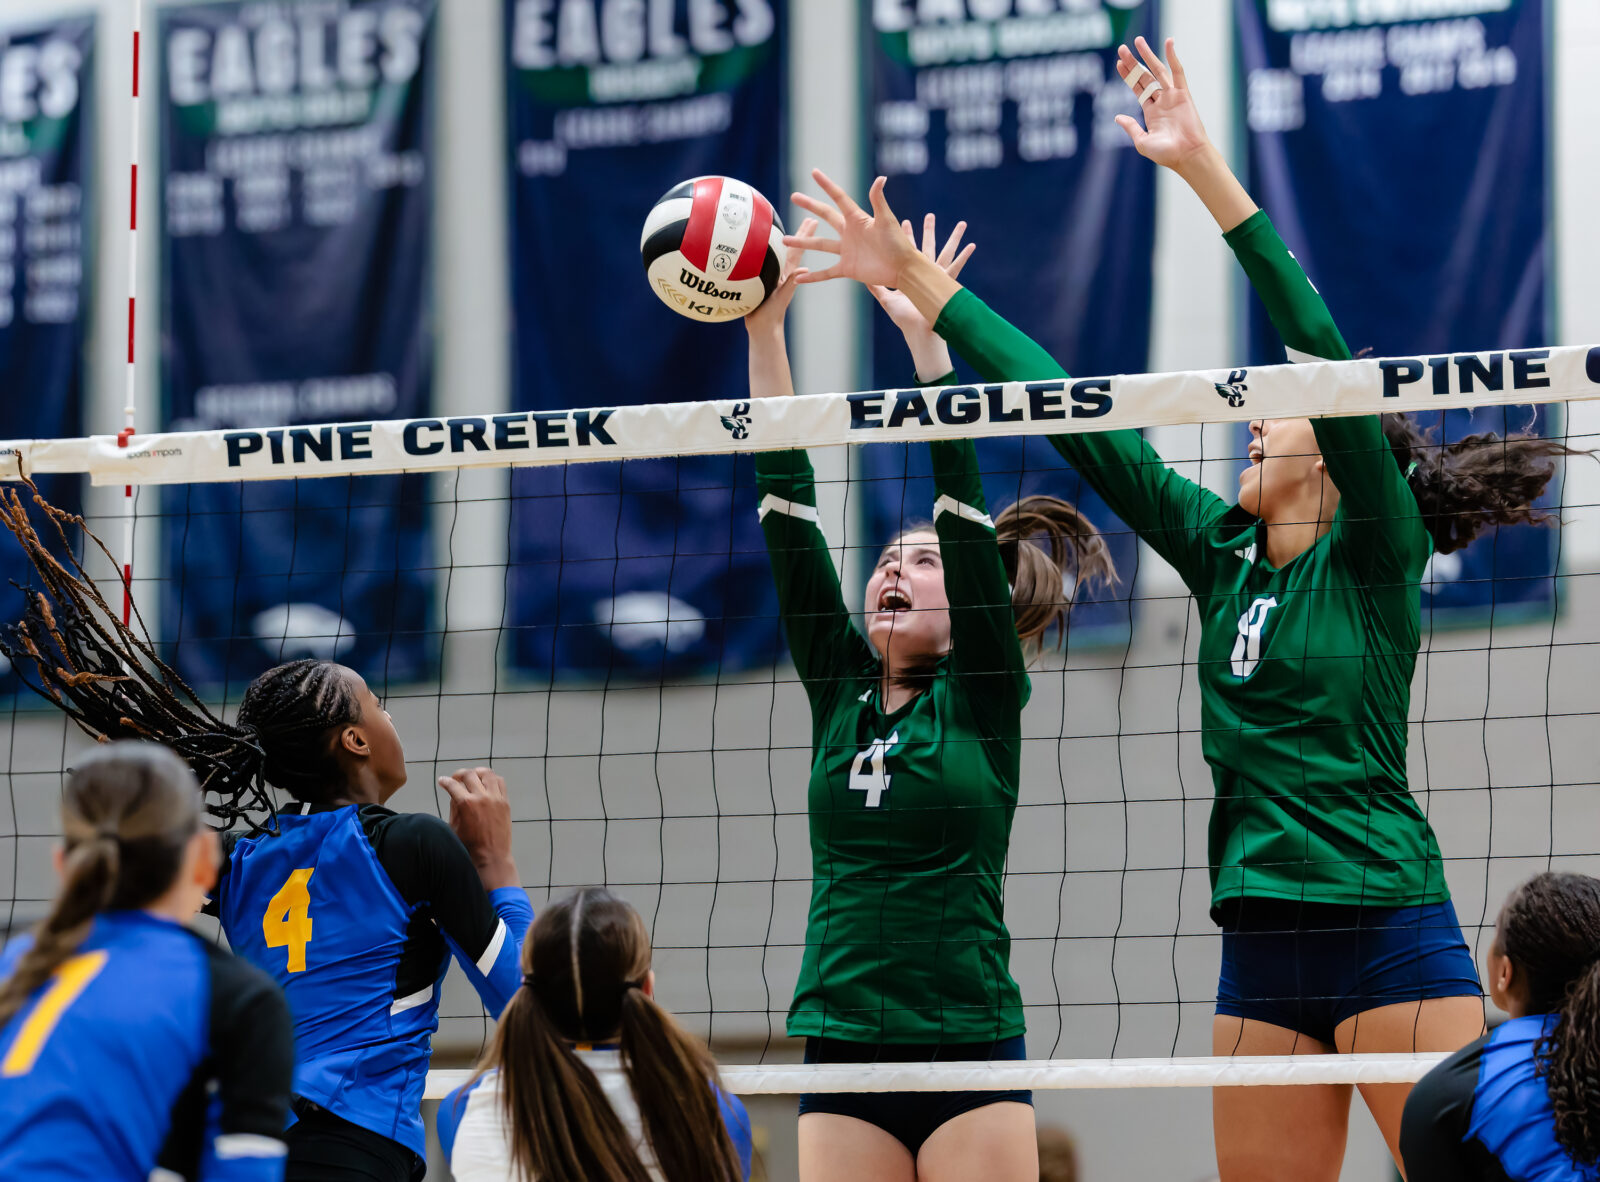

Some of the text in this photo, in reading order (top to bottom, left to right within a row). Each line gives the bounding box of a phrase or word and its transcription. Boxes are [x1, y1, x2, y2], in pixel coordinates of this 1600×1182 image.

[168, 7, 423, 105] EAGLES
[513, 0, 775, 69] EAGLES
[680, 268, 742, 301] Wilson
[845, 379, 1113, 429] EAGLES
[1379, 350, 1550, 398] PINE
[223, 410, 617, 467] PINE CREEK
[1230, 596, 1277, 677] 8
[849, 730, 899, 807] 4
[263, 867, 315, 973] 4
